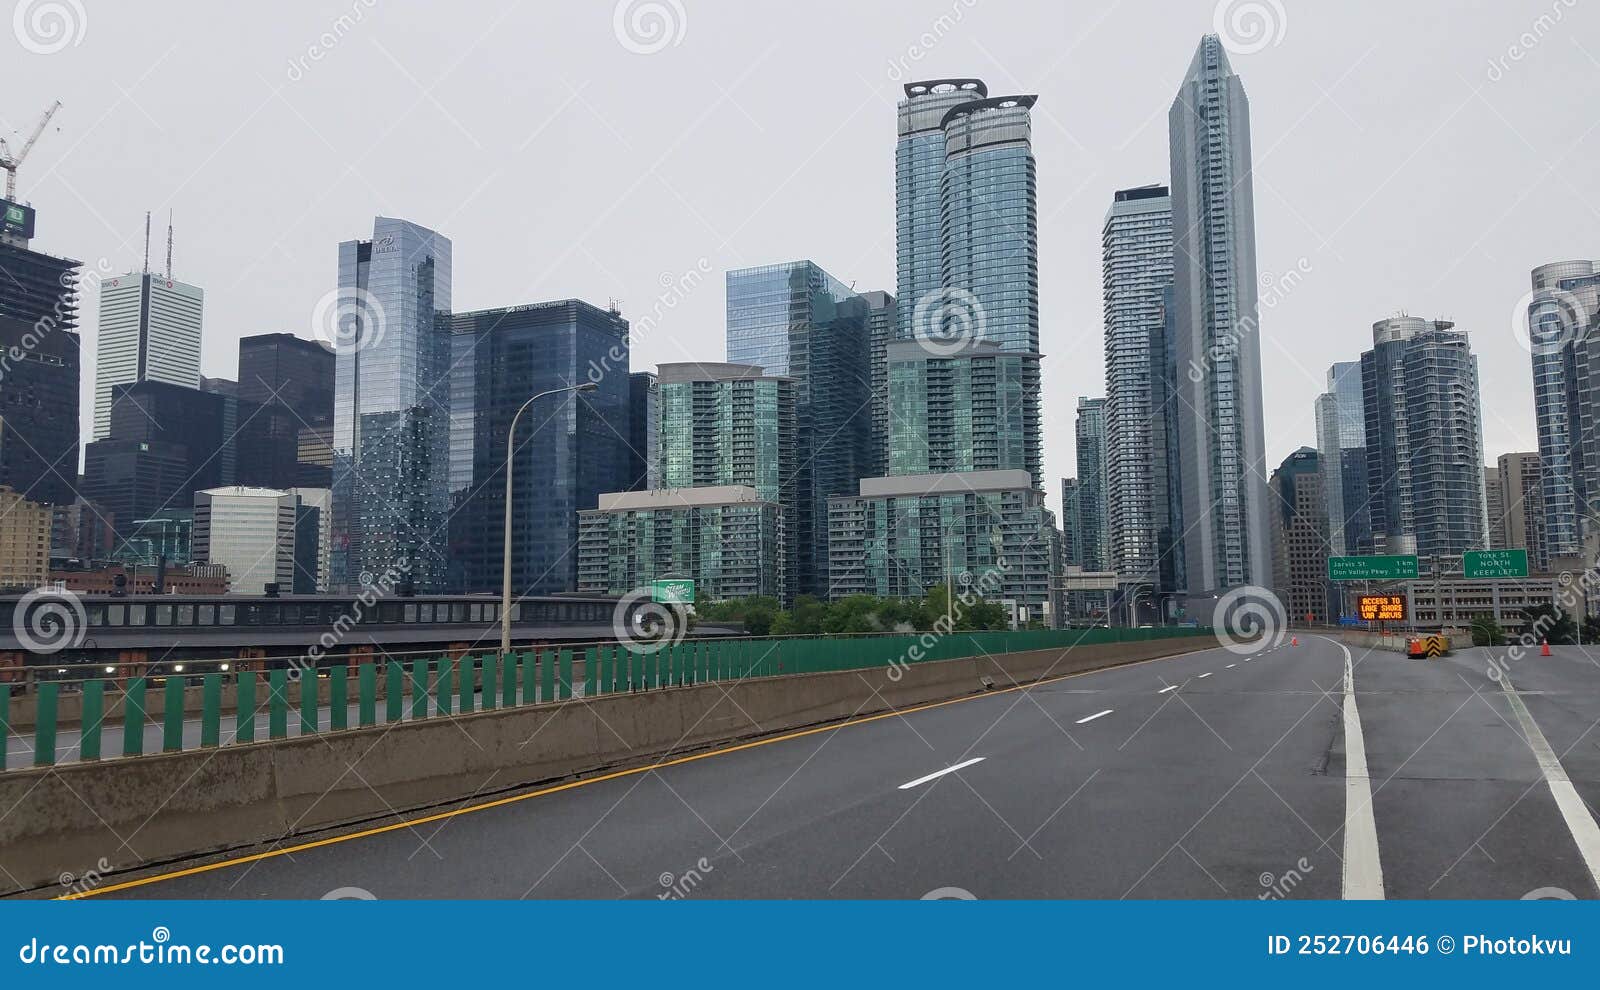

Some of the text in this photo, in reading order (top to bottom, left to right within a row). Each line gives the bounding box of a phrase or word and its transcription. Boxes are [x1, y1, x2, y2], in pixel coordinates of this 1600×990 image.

[1478, 551, 1498, 559] York
[1333, 568, 1347, 576] Don
[1348, 568, 1369, 576] Valley
[1473, 569, 1496, 577] KEEP
[1362, 597, 1401, 605] ACCESS TO
[1381, 604, 1403, 612] SHORE
[1378, 611, 1402, 619] JARVIS
